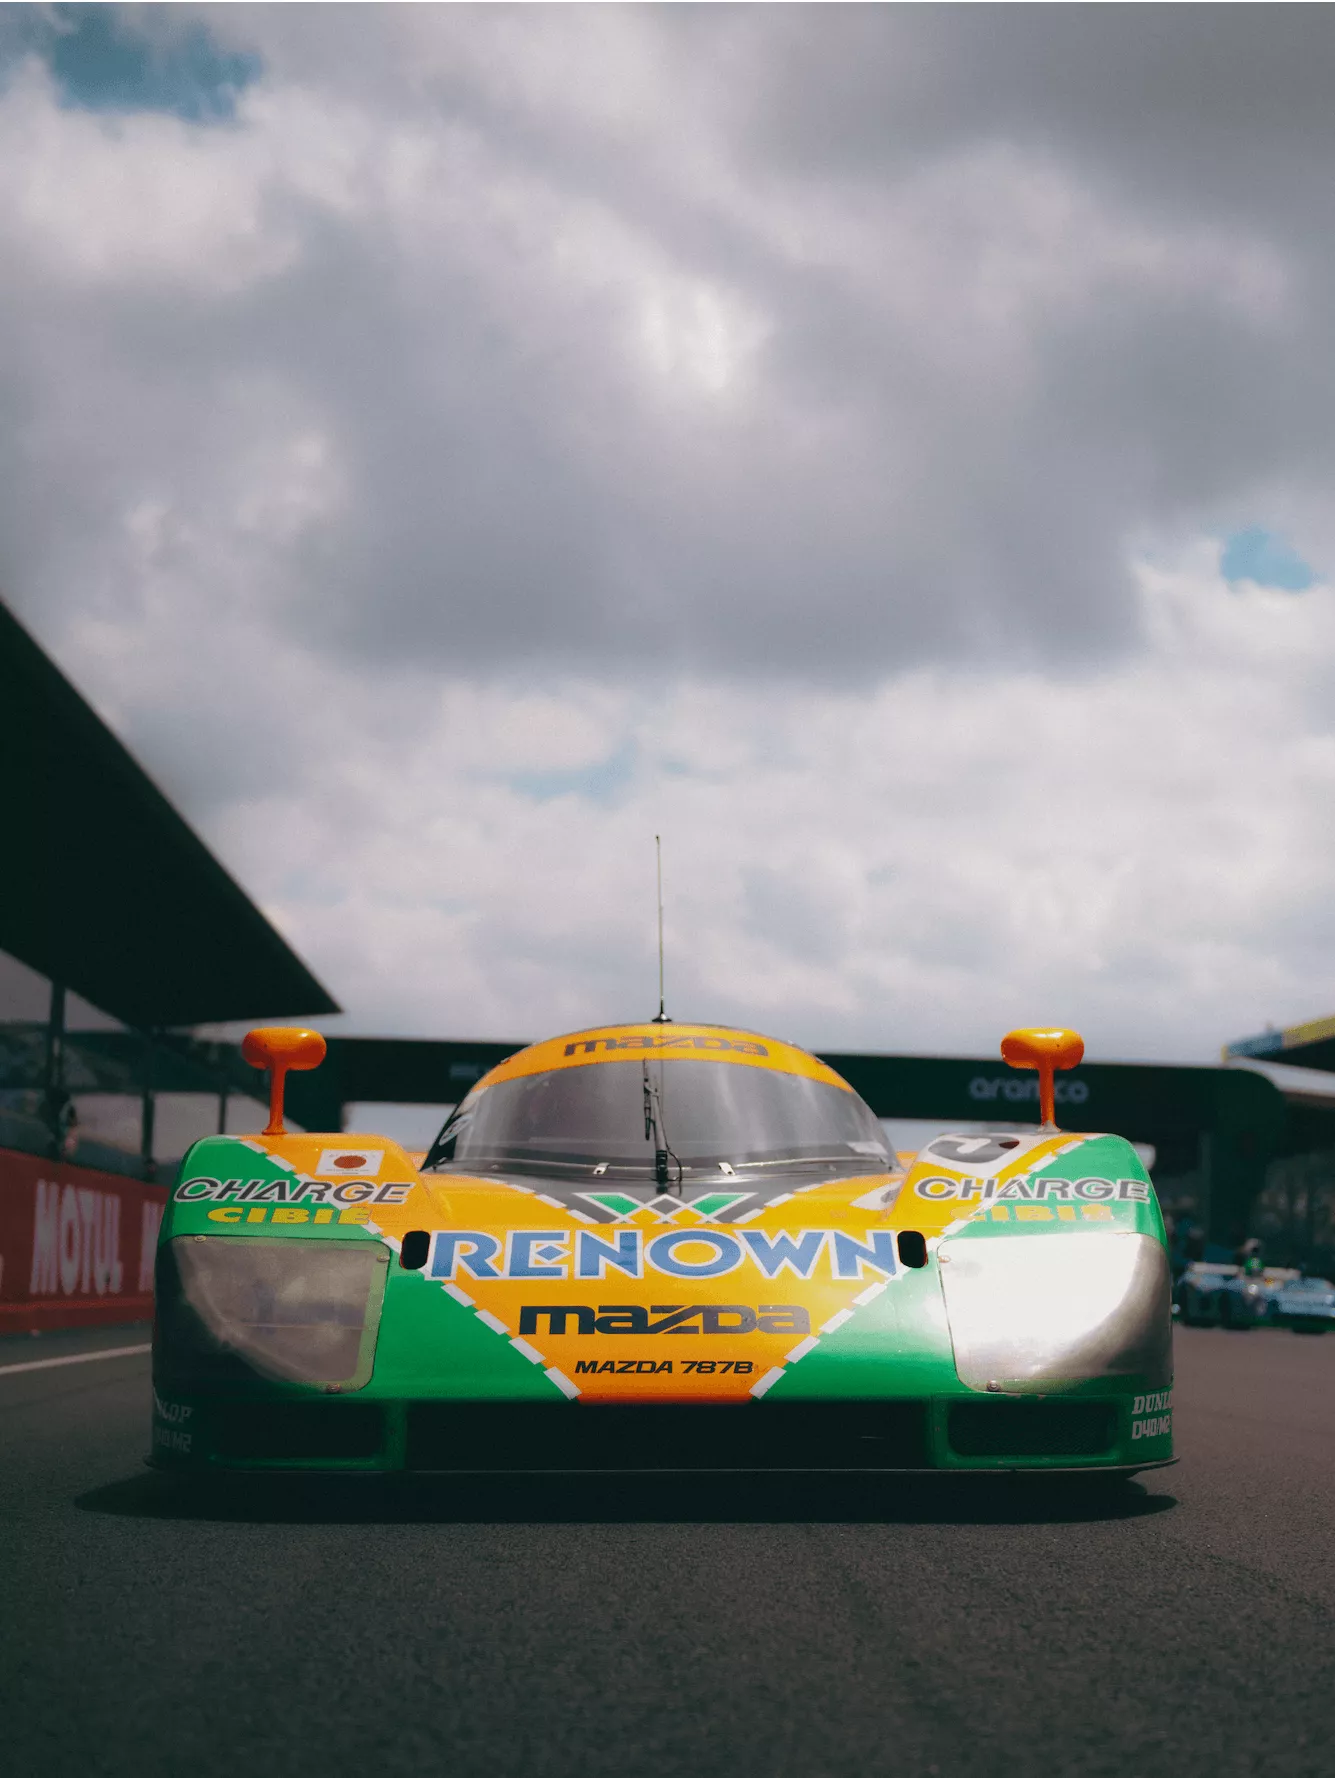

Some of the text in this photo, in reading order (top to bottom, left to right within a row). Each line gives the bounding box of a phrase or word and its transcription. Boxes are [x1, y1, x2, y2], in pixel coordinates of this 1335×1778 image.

[564, 1035, 769, 1057] mazda
[174, 1177, 414, 1205] CHARGE
[914, 1176, 1150, 1203] CHARGE
[29, 1179, 122, 1295] MOTUL
[428, 1230, 900, 1280] RENOWN
[518, 1305, 811, 1335] mazda
[575, 1361, 753, 1374] MAZDA 787B
